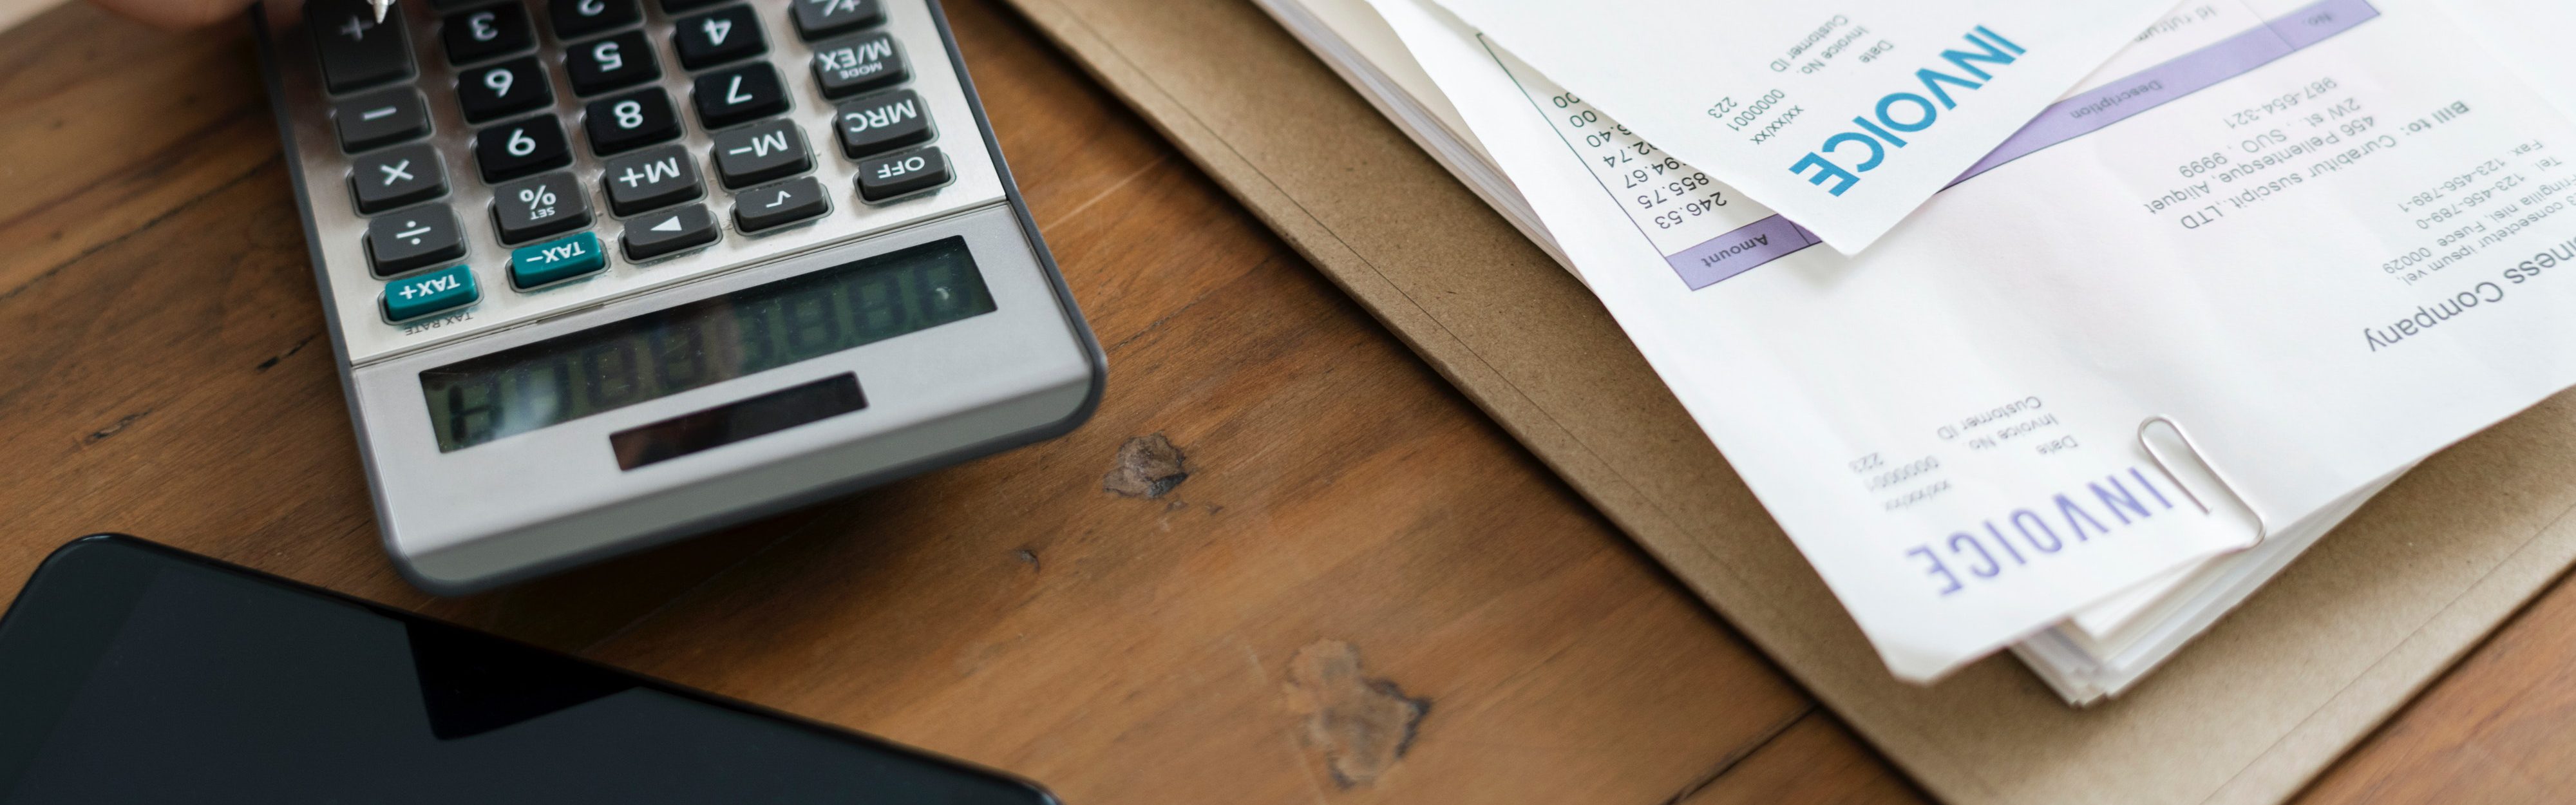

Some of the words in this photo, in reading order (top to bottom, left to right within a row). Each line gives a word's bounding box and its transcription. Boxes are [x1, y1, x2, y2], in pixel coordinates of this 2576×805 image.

[468, 12, 498, 41] 3
[703, 19, 732, 46] 4
[1785, 13, 1848, 58] Customer
[592, 42, 622, 71] 5
[818, 38, 892, 71] M/EX
[1819, 24, 1869, 61] Invoice
[1859, 39, 1893, 66] Date
[840, 62, 883, 79] MODE
[1769, 55, 1790, 73] ID
[484, 69, 513, 97] 6
[726, 75, 752, 104] 7
[613, 100, 643, 129] 8
[1707, 96, 1738, 120] 223
[1725, 88, 1785, 133] 0000001
[1788, 24, 2027, 197] INVOICE
[2069, 80, 2163, 120] Description
[2222, 77, 2337, 130] 987-654-321
[2326, 97, 2361, 121] 2W
[2430, 100, 2470, 125] Bill
[845, 99, 917, 133] MRC
[1750, 104, 1804, 146] xx/xx/xx
[2340, 115, 2374, 137] 456
[2400, 118, 2432, 136] to:
[507, 128, 536, 156] 9
[1602, 132, 1658, 168] 2.74
[2241, 129, 2287, 153] SUO
[877, 156, 925, 179] OFF
[2179, 152, 2228, 178] 9999
[2211, 130, 2340, 183] Pellentesque,
[2307, 134, 2396, 178] Curabitur
[620, 156, 680, 188] M+
[1622, 155, 1687, 189] 94.67
[2397, 157, 2506, 214] 123-456-789-1
[520, 185, 556, 210] %
[1636, 171, 1709, 210] 855.75
[2143, 181, 2210, 214] Aliquet
[2415, 172, 2525, 230] 123-456-789-0
[529, 206, 555, 220] SET
[1654, 191, 1727, 230] 246.53
[2477, 201, 2564, 248] consectetur
[2436, 221, 2486, 249] Fusce
[1701, 232, 1770, 269] Amount
[2382, 247, 2432, 275] 00029
[2428, 244, 2477, 272] ipsum
[2503, 238, 2576, 284] iness
[399, 274, 460, 299] TAX+
[404, 318, 440, 336] RATE
[441, 312, 473, 323] TAX
[2363, 281, 2504, 352] Company
[1958, 395, 2042, 431] Customer
[1997, 413, 2060, 441] Invoice
[1936, 425, 1961, 442] ID
[2035, 434, 2078, 457] Date
[1904, 466, 2175, 599] INVOICE
